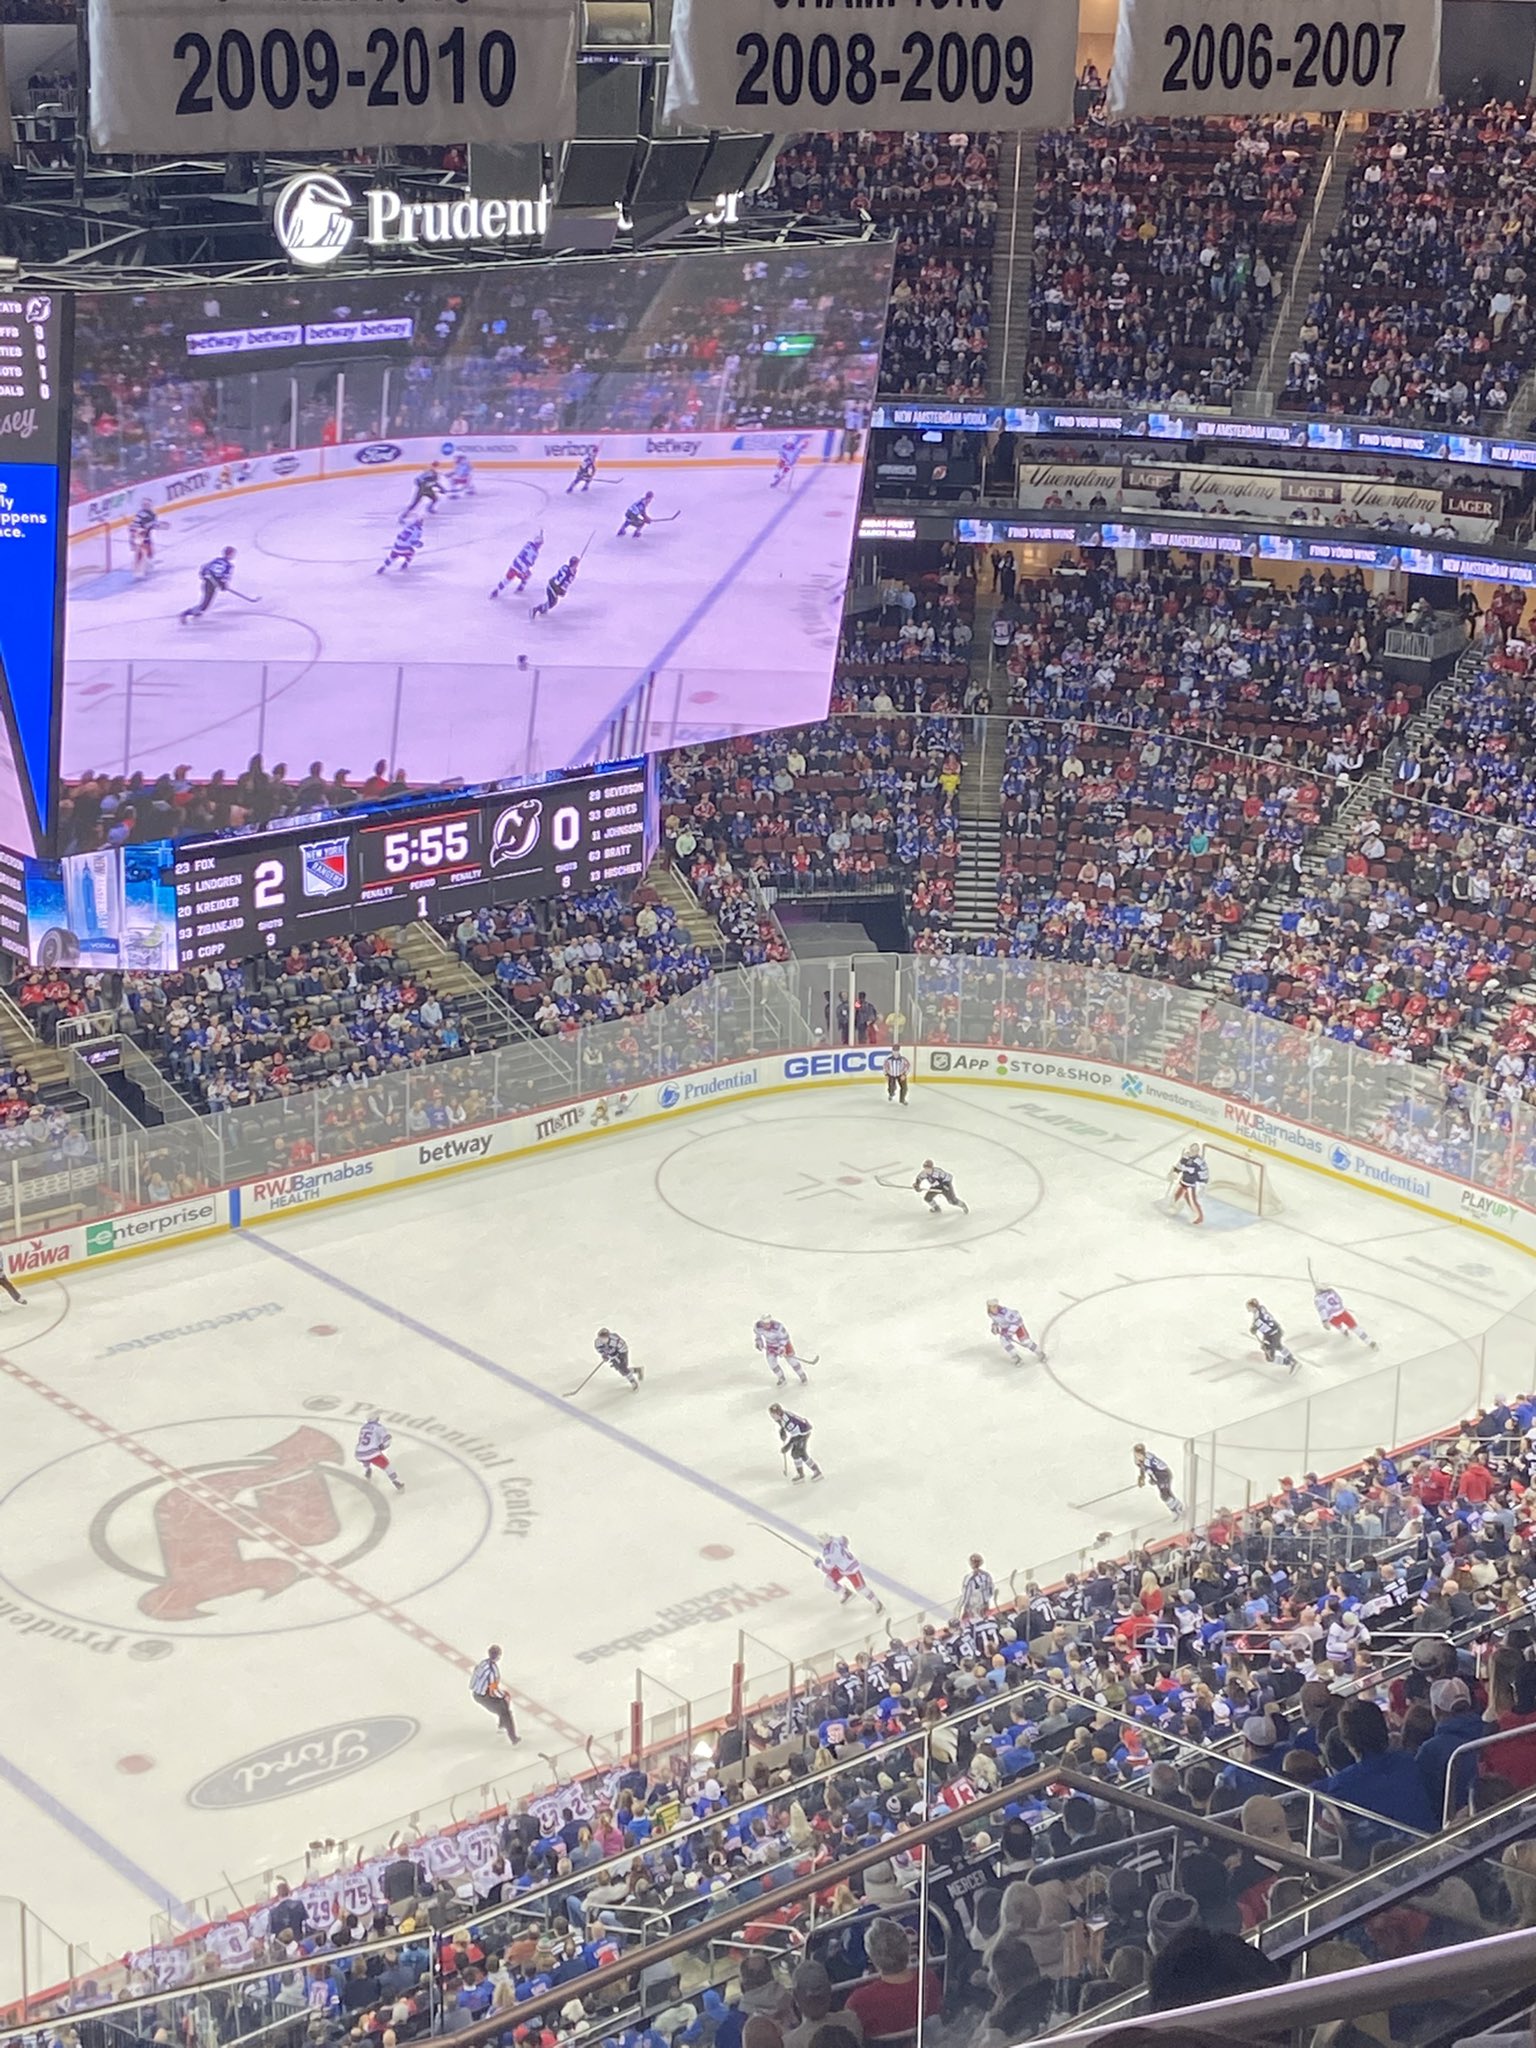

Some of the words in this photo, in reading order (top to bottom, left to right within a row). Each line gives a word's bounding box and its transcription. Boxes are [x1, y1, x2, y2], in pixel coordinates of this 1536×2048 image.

[736, 31, 1033, 106] 2008-2009
[1163, 22, 1405, 92] 2006-2007
[173, 26, 516, 115] 2009-2010
[363, 183, 551, 245] Prudent
[1054, 416, 1075, 427] FIND
[1075, 416, 1098, 428] YOUR
[645, 438, 702, 456] betway
[1359, 433, 1379, 446] FIND
[1380, 435, 1401, 448] YOUR
[1028, 465, 1118, 490] Yuengling
[1190, 473, 1276, 499] Yuengling
[1287, 484, 1334, 500] LAGER
[1351, 484, 1438, 512] Yuengling
[1448, 498, 1493, 515] LAGER
[1008, 527, 1028, 538] FIND
[1028, 528, 1051, 539] YOUR
[1310, 545, 1330, 557] FIND
[1331, 546, 1353, 559] YOUR
[604, 803, 637, 818] GRAVES
[553, 806, 580, 851] 0
[385, 822, 468, 873] 5:55
[604, 844, 632, 859] BRATT
[175, 862, 190, 874] 23
[195, 857, 215, 871] FOX
[451, 869, 482, 883] PENALTY
[177, 884, 191, 896] 55
[195, 874, 242, 892] LINDGREN
[254, 860, 285, 909] 2
[362, 886, 394, 900] PENALTY
[410, 878, 436, 890] PERIOD
[196, 896, 239, 914] KREIDER
[417, 896, 428, 917] 1
[198, 943, 225, 958] COPP
[684, 1068, 758, 1100] Prudential
[1010, 1060, 1112, 1085] STOP&SHOP
[1236, 1125, 1276, 1148] HEALTH
[418, 1134, 493, 1165] betway
[1354, 1156, 1431, 1199] Prudential
[269, 1187, 320, 1210] HEALTH
[88, 1203, 213, 1250] enterprise
[500, 1477, 539, 1538] Center
[233, 1728, 369, 1792] Ford
